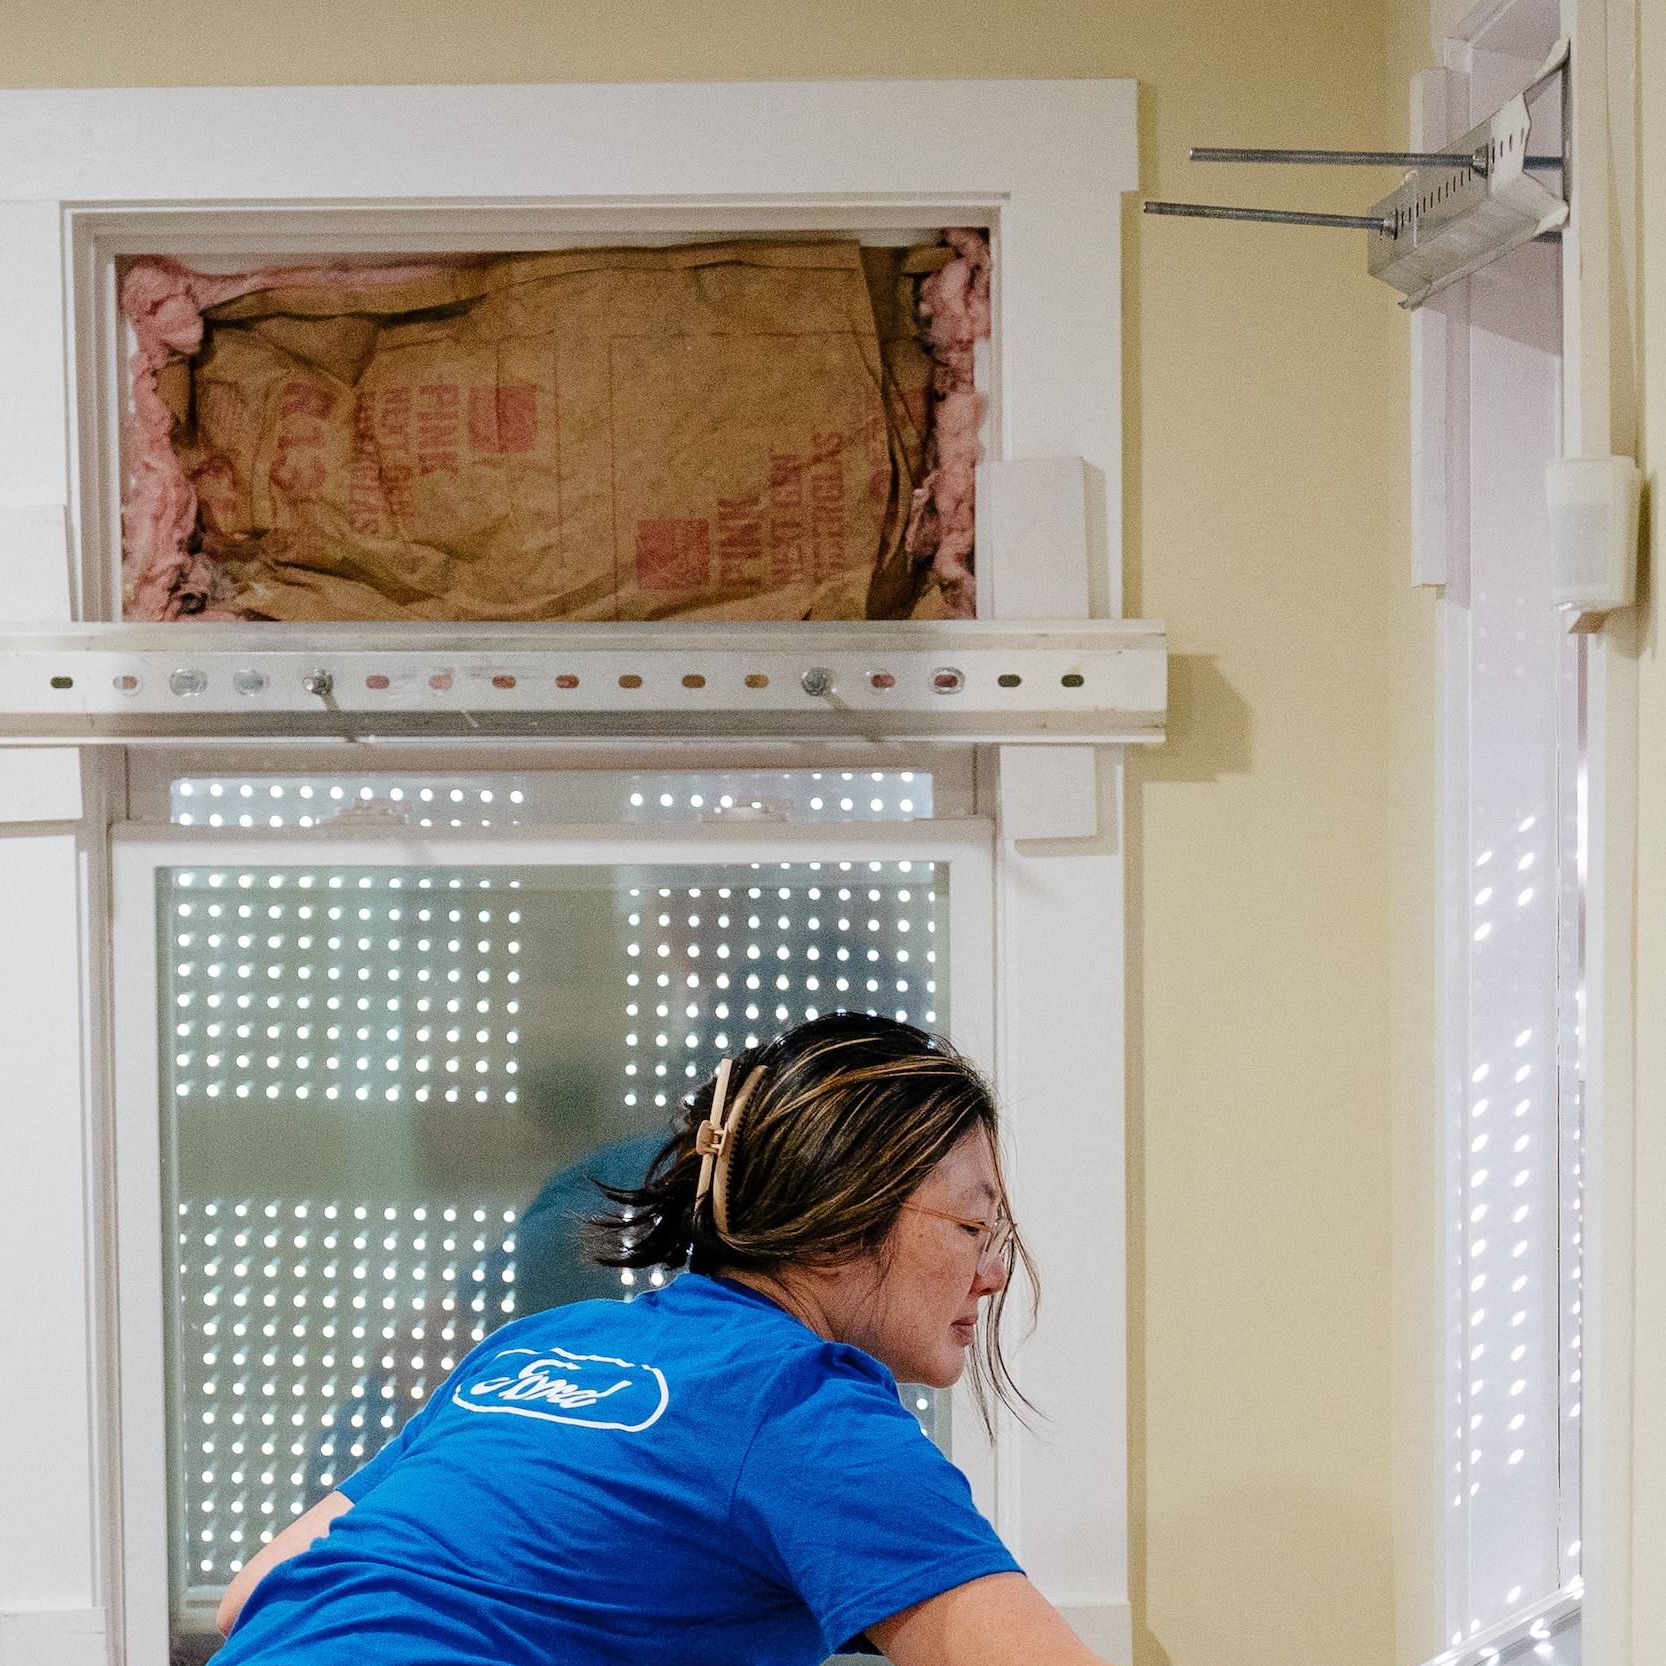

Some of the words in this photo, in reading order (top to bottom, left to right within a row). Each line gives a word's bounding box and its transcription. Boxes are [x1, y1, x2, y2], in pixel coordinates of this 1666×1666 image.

[383, 386, 413, 455] NEXT
[417, 384, 460, 477] PINK
[771, 454, 802, 508] GEN
[717, 493, 762, 588] PINK
[771, 518, 804, 585] NEXT
[470, 1358, 632, 1409] Ford
